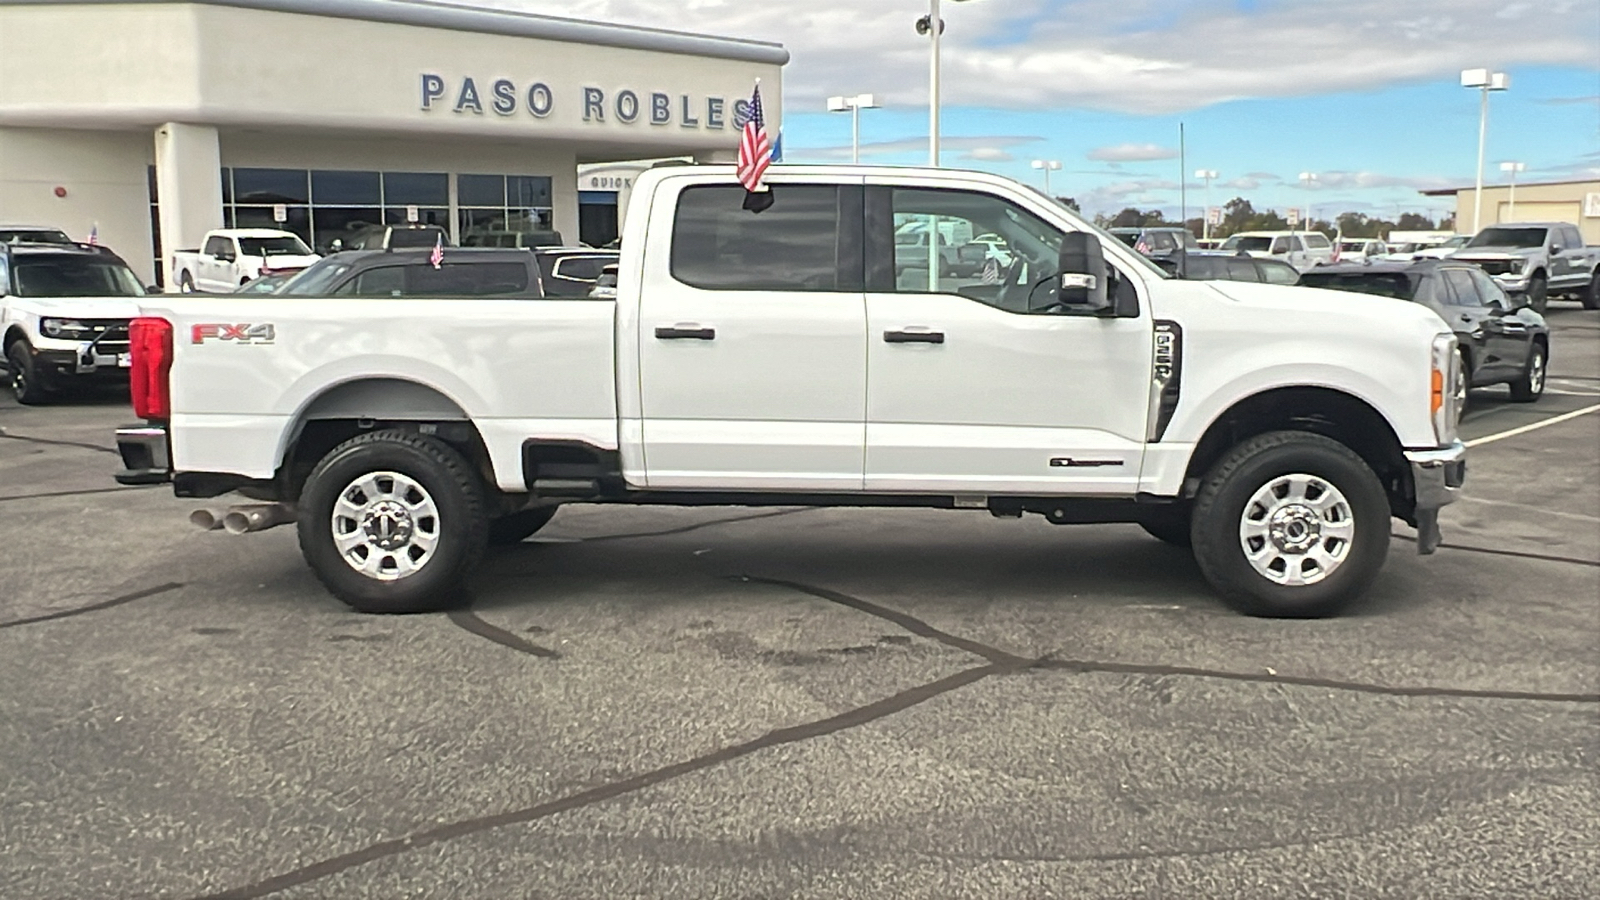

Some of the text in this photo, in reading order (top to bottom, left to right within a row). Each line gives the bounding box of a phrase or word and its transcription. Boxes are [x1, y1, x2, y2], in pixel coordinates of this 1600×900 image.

[420, 73, 752, 131] PASO ROBLES
[191, 323, 275, 344] FX4
